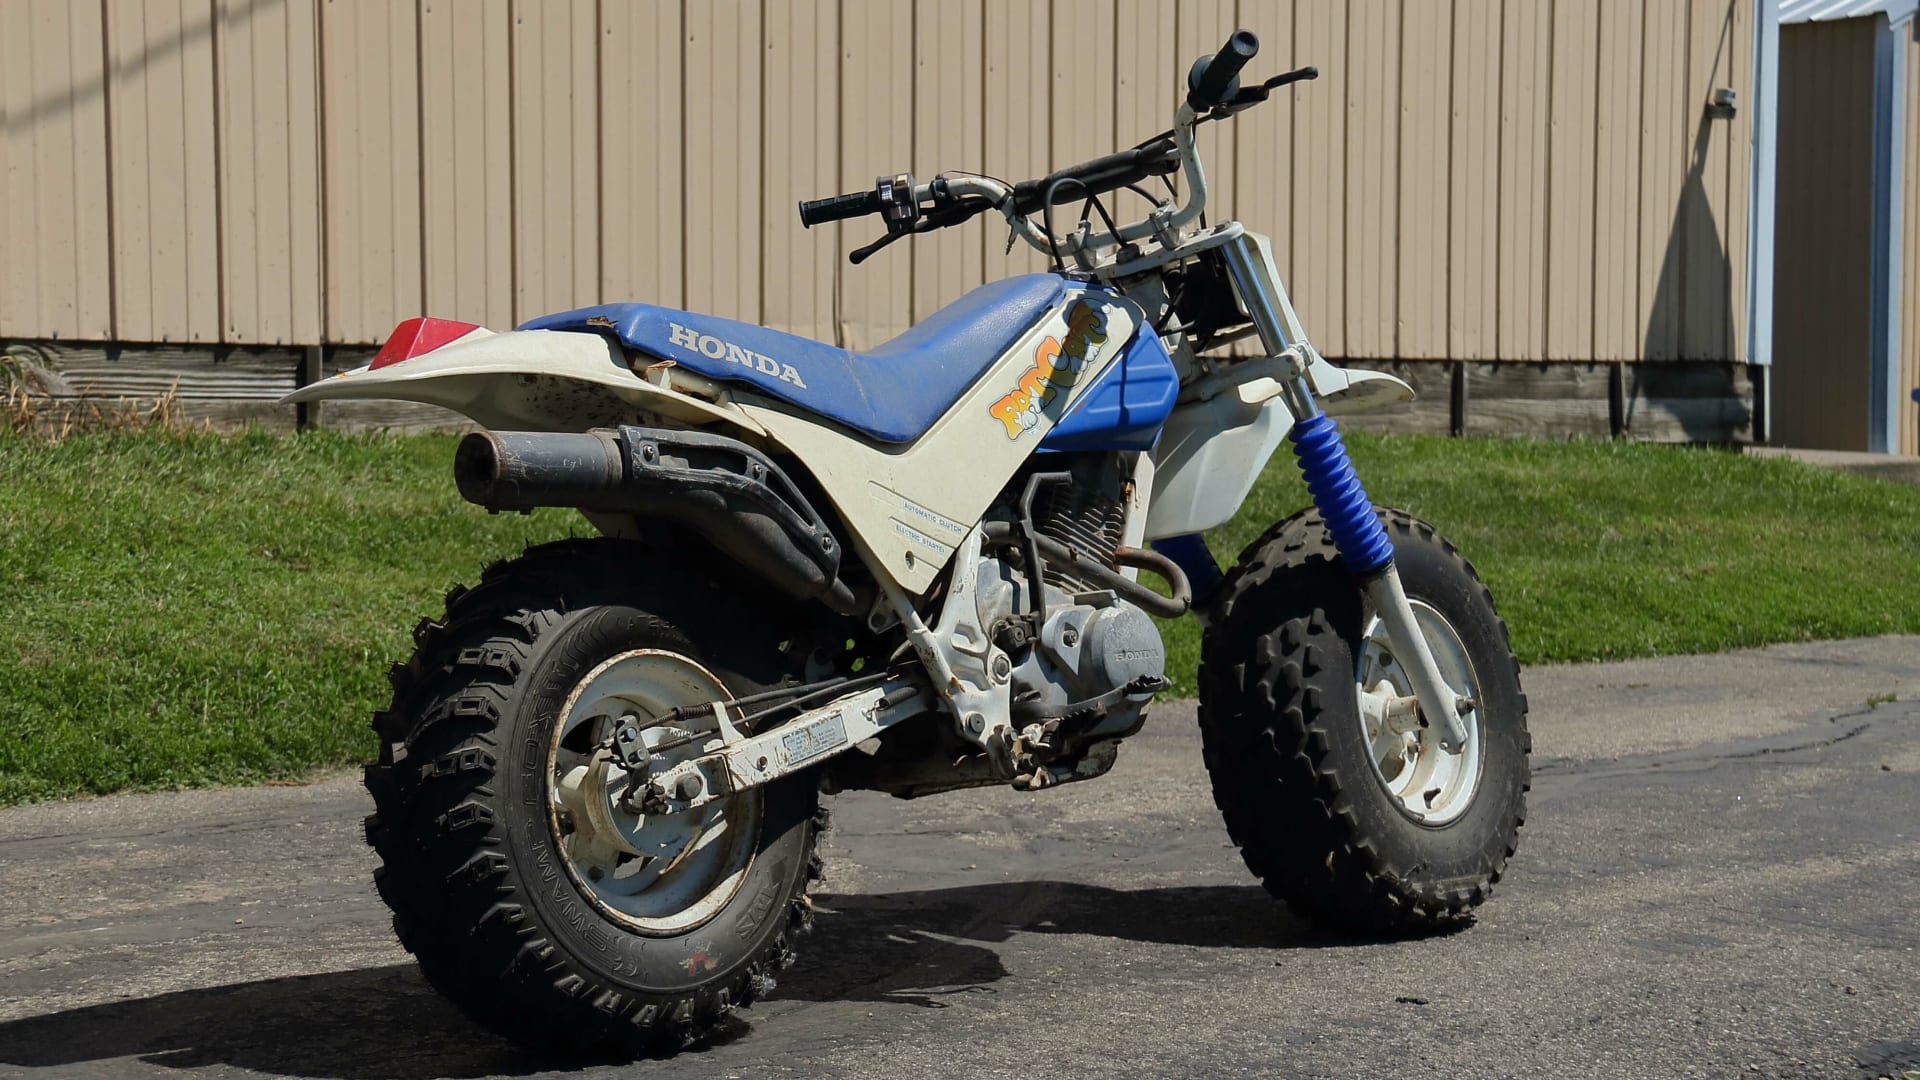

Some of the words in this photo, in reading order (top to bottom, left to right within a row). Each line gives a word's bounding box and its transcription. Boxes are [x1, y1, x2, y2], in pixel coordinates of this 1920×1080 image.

[669, 322, 807, 389] HONDA
[896, 524, 920, 541] ELECTRIC
[904, 502, 937, 523] AUTOMATIC
[939, 519, 962, 534] CLUTCH
